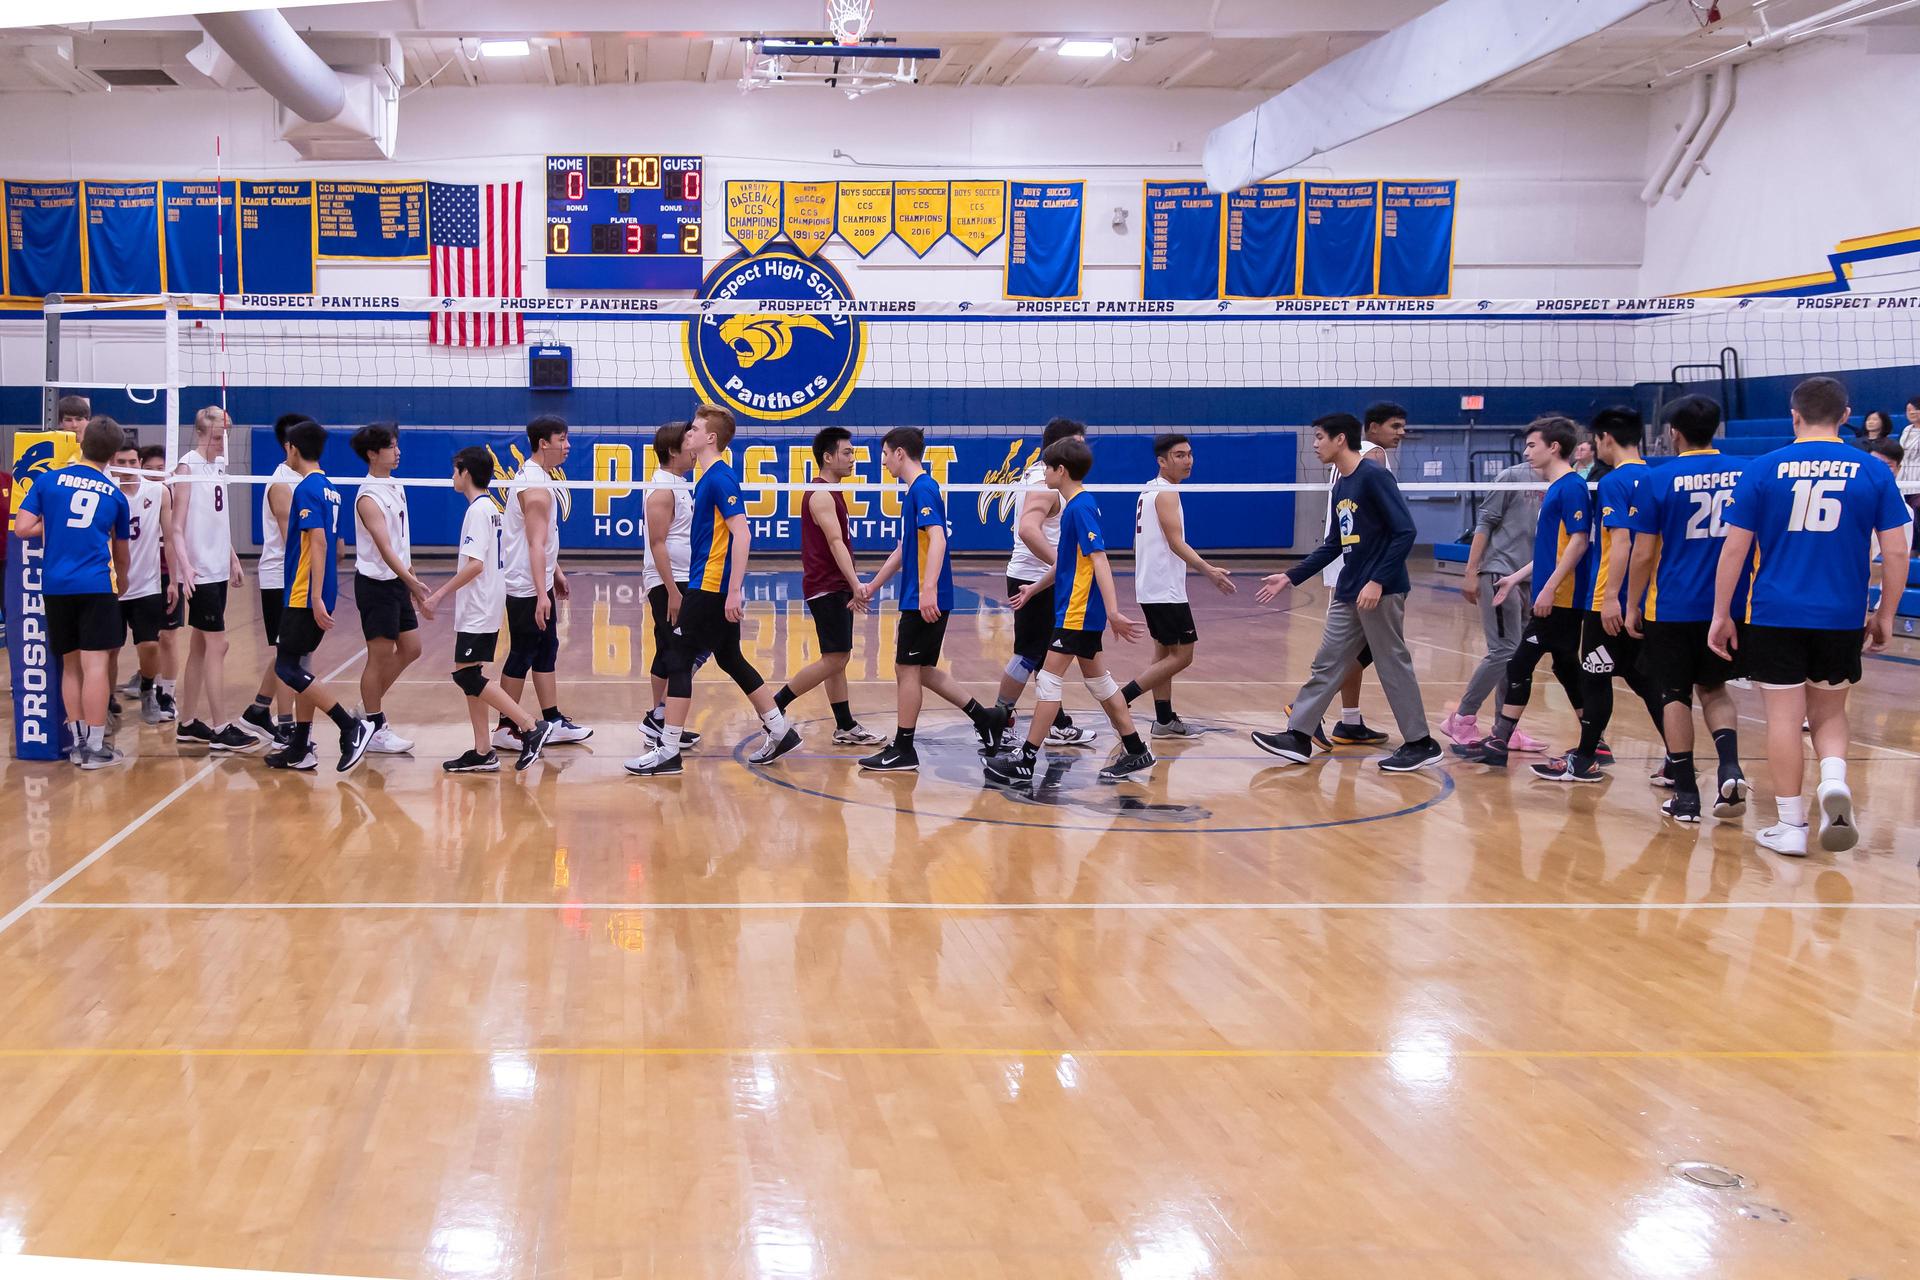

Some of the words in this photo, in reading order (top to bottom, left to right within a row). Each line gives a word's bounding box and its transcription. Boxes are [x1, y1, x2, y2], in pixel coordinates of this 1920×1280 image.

[548, 159, 583, 170] HOME
[663, 159, 701, 171] GUEST
[616, 157, 658, 186] 1:00
[278, 186, 299, 194] GOLF
[319, 184, 335, 193] CCS
[338, 185, 378, 194] INDIVIDUAL
[381, 185, 423, 194] CHAMPIONS
[567, 172, 583, 200] 0
[684, 172, 700, 200] 0
[740, 183, 769, 191] VARSITY
[841, 188, 860, 197] BOYS
[975, 189, 1000, 197] SOCCER
[241, 197, 268, 205] LEAGUE
[730, 191, 778, 208] BASEBALL
[794, 196, 826, 204] SOCCER
[744, 204, 763, 215] CCS
[857, 202, 873, 210] CCS
[730, 217, 778, 228] CHAMPIONS
[788, 217, 830, 225] CHAMPIONS
[843, 215, 887, 223] CHAMPIONS
[957, 217, 997, 225] CHAMPIONS
[553, 224, 569, 253] 0
[627, 224, 642, 253] 3
[684, 224, 700, 253] 2
[737, 229, 769, 240] 1981-82
[704, 264, 761, 327] Pspect
[765, 261, 804, 280] High
[806, 272, 848, 327] Schol
[242, 295, 314, 307] PROSPECT
[322, 296, 399, 308] PANTHERS
[500, 298, 574, 309] PROSPECT
[581, 299, 658, 310] PANTHERS
[758, 300, 831, 311] PROSPECT
[839, 301, 916, 312] PANTHERS
[1016, 301, 1090, 312] PROSPECT
[1096, 301, 1174, 312] PANTHERS
[1276, 300, 1349, 311] PROSPECT
[1356, 300, 1434, 311] PANTHERS
[1536, 299, 1610, 310] PROSPECT
[1616, 298, 1695, 310] PANTHERS
[1796, 298, 1871, 308] PROSPECT
[1877, 297, 1920, 308] PANT
[725, 375, 828, 409] Panthers
[1777, 460, 1860, 479] PROSPECT
[57, 474, 115, 496] PROSPECT
[214, 485, 224, 512] 8
[66, 490, 100, 529] 9
[1788, 479, 1846, 532] 16
[22, 540, 48, 744] PROSPECT
